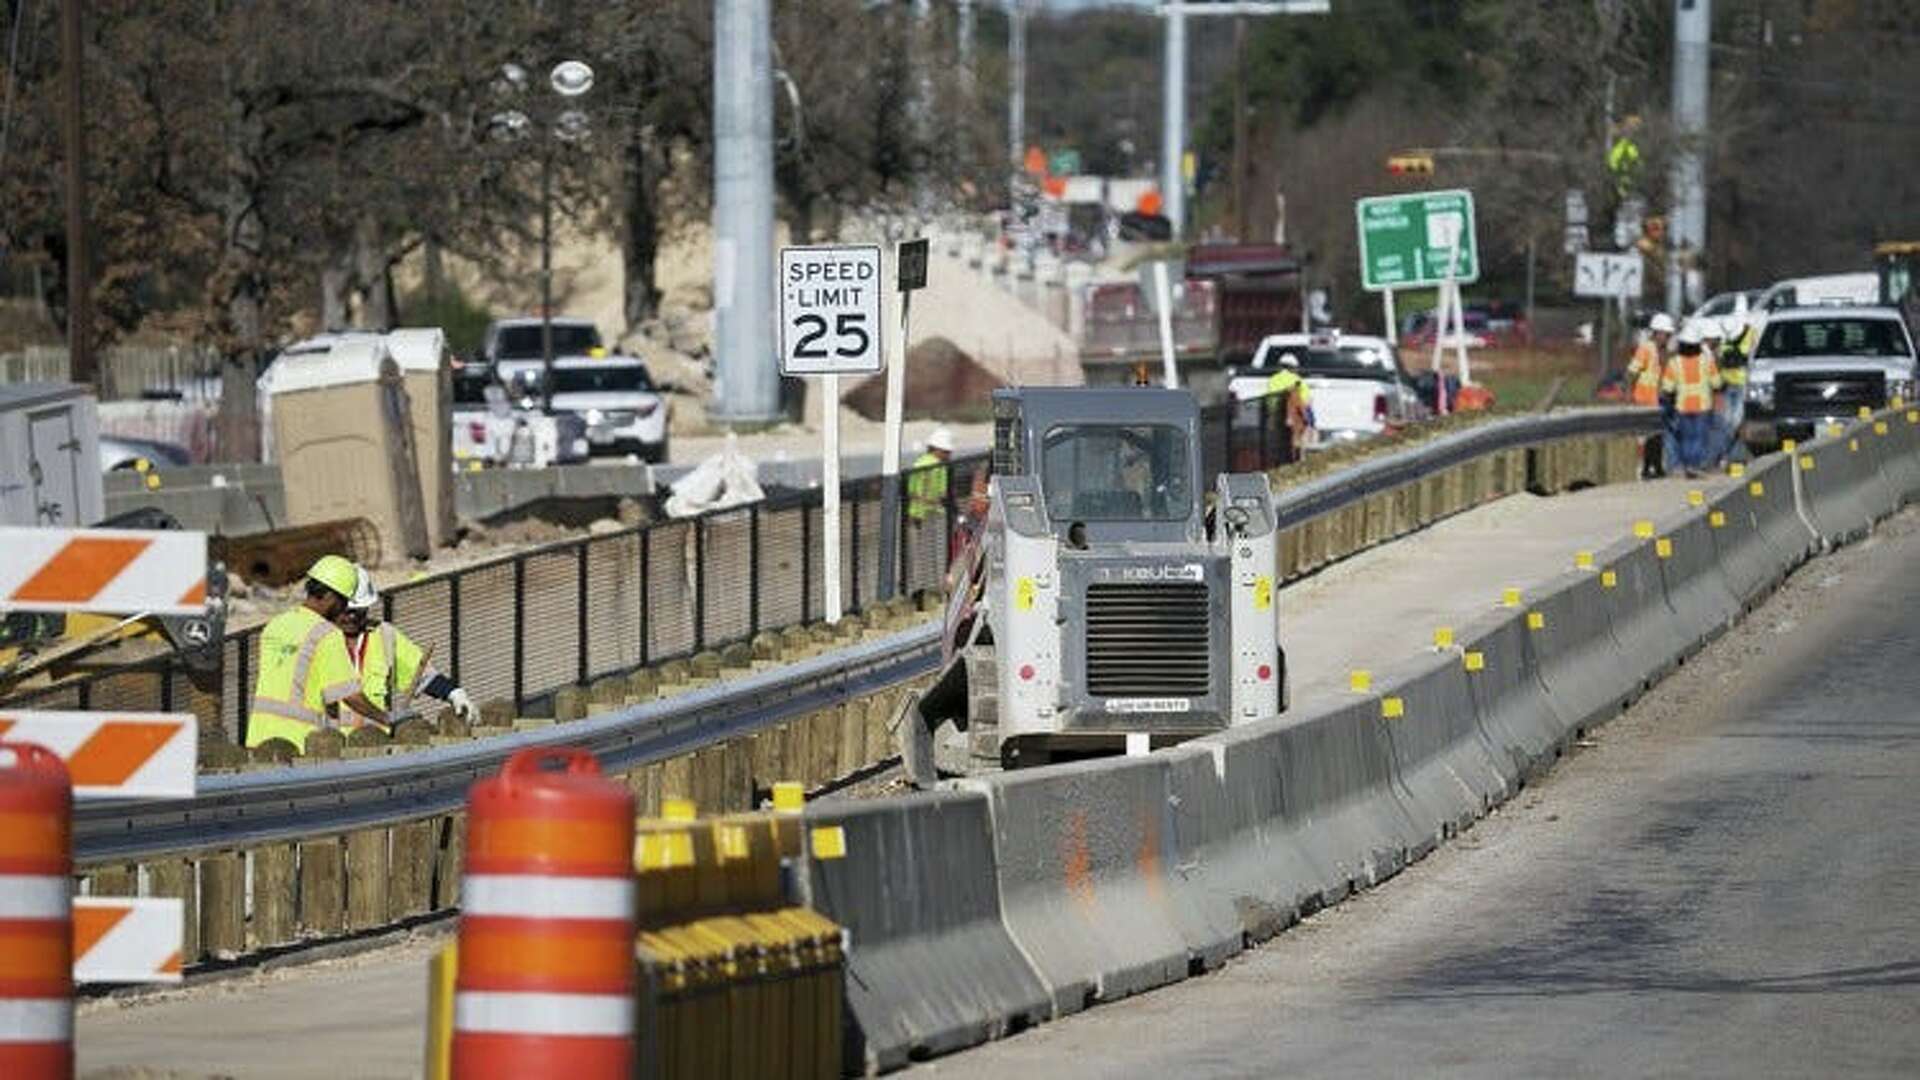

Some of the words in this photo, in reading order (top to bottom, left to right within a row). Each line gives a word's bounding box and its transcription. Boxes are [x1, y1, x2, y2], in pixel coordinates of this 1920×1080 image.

[789, 261, 874, 282] SPEED
[798, 287, 863, 307] LIMIT
[793, 313, 870, 359] 25
